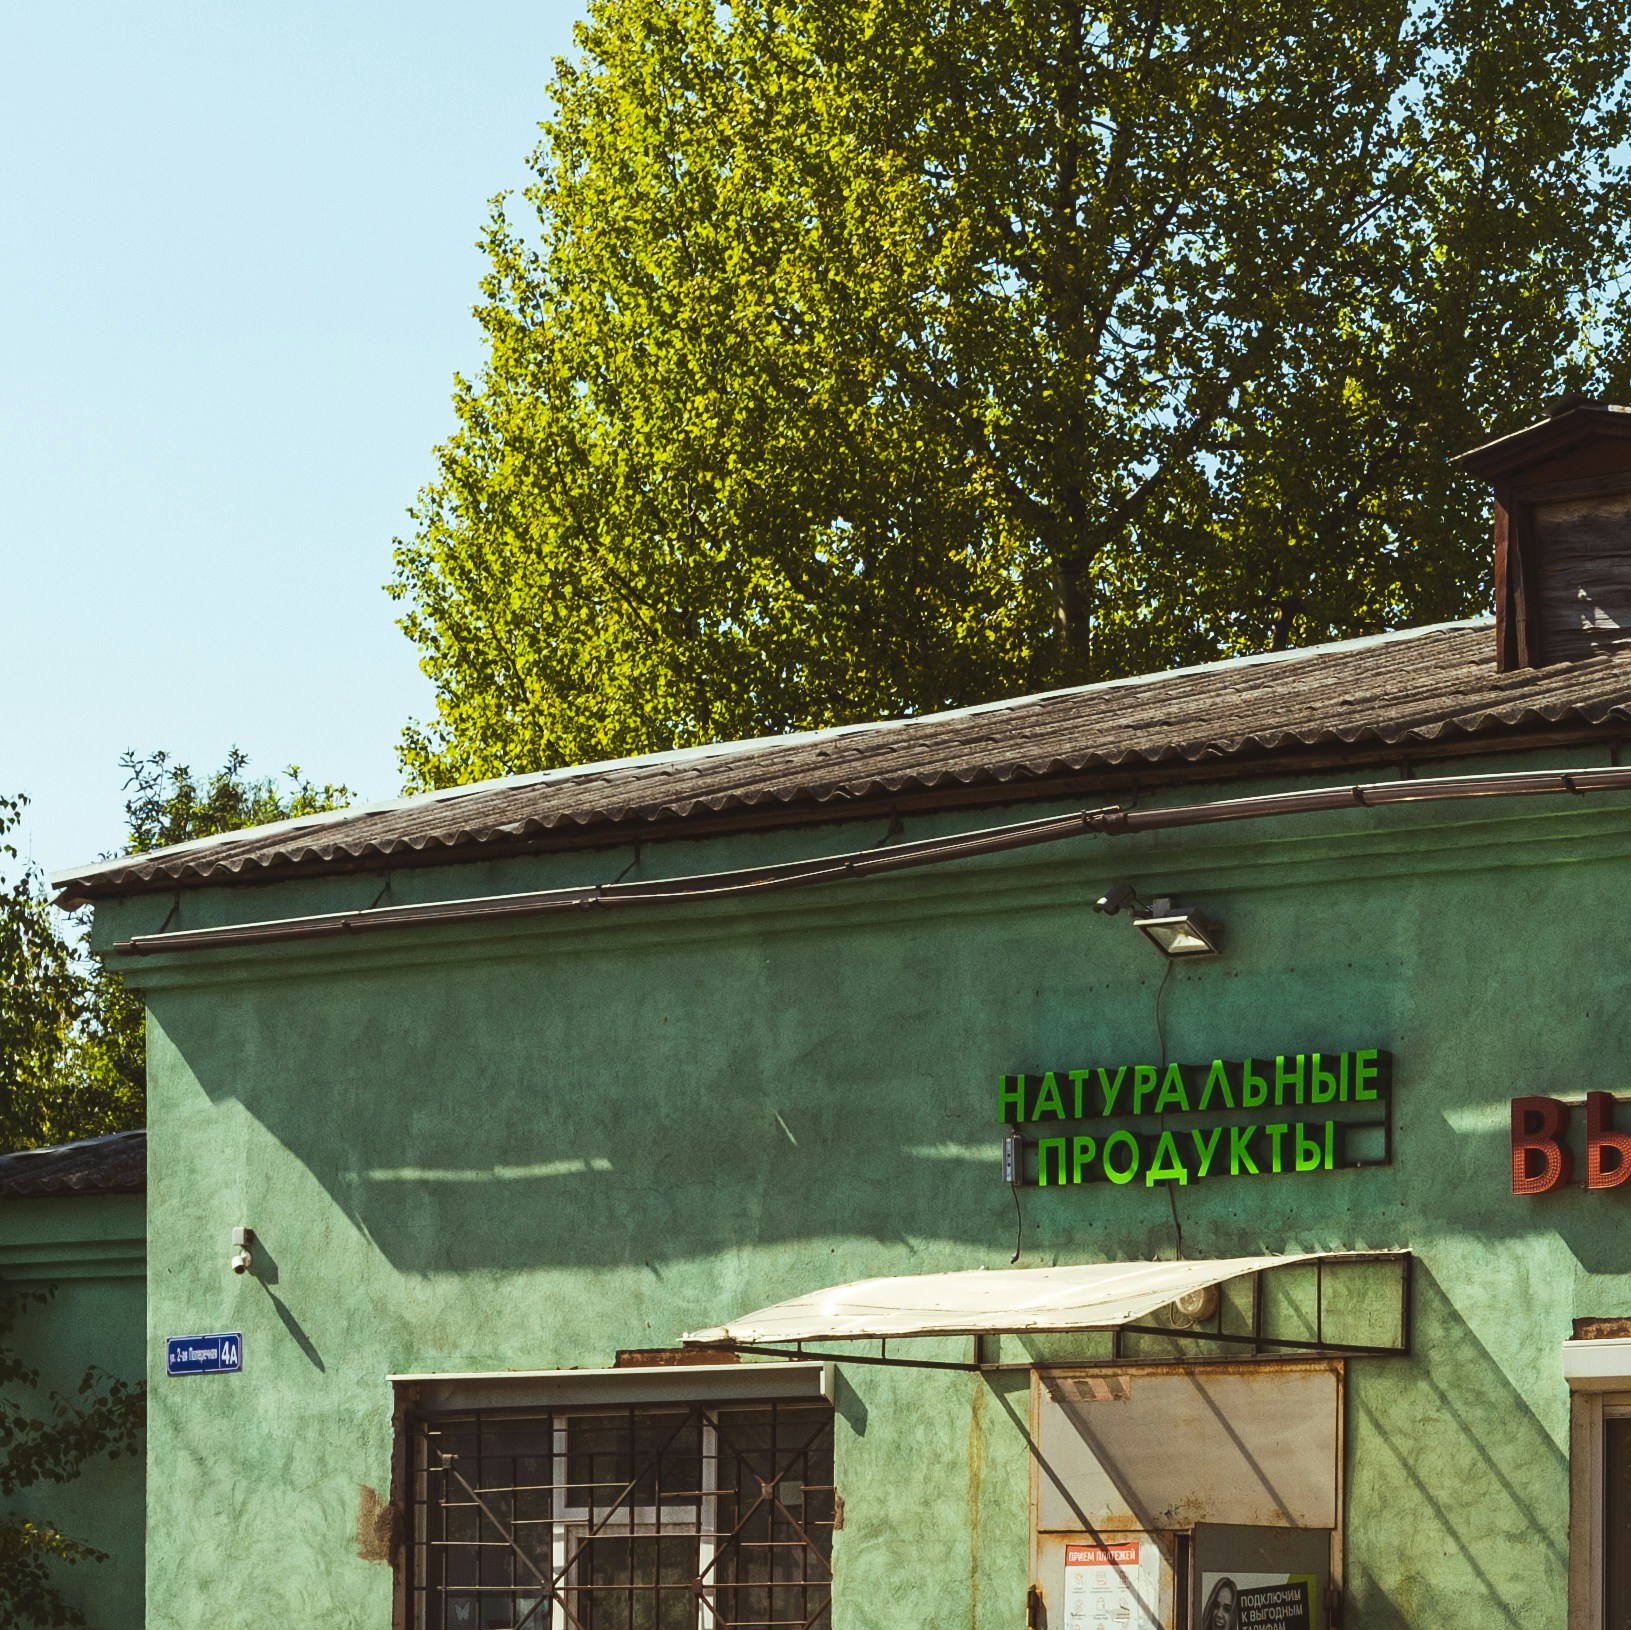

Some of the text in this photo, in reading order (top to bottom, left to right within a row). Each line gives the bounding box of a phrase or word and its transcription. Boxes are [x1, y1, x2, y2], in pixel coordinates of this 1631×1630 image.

[1000, 1048, 1382, 1123] НАТУРАЛЬНЫЕ
[1037, 1120, 1335, 1187] ПРОДУКТЫ
[221, 1340, 238, 1365] 4А
[1240, 1588, 1302, 1609] ПОДКЛЮЧИМ
[1241, 1604, 1303, 1623] К ВЫГОДНЫМ
